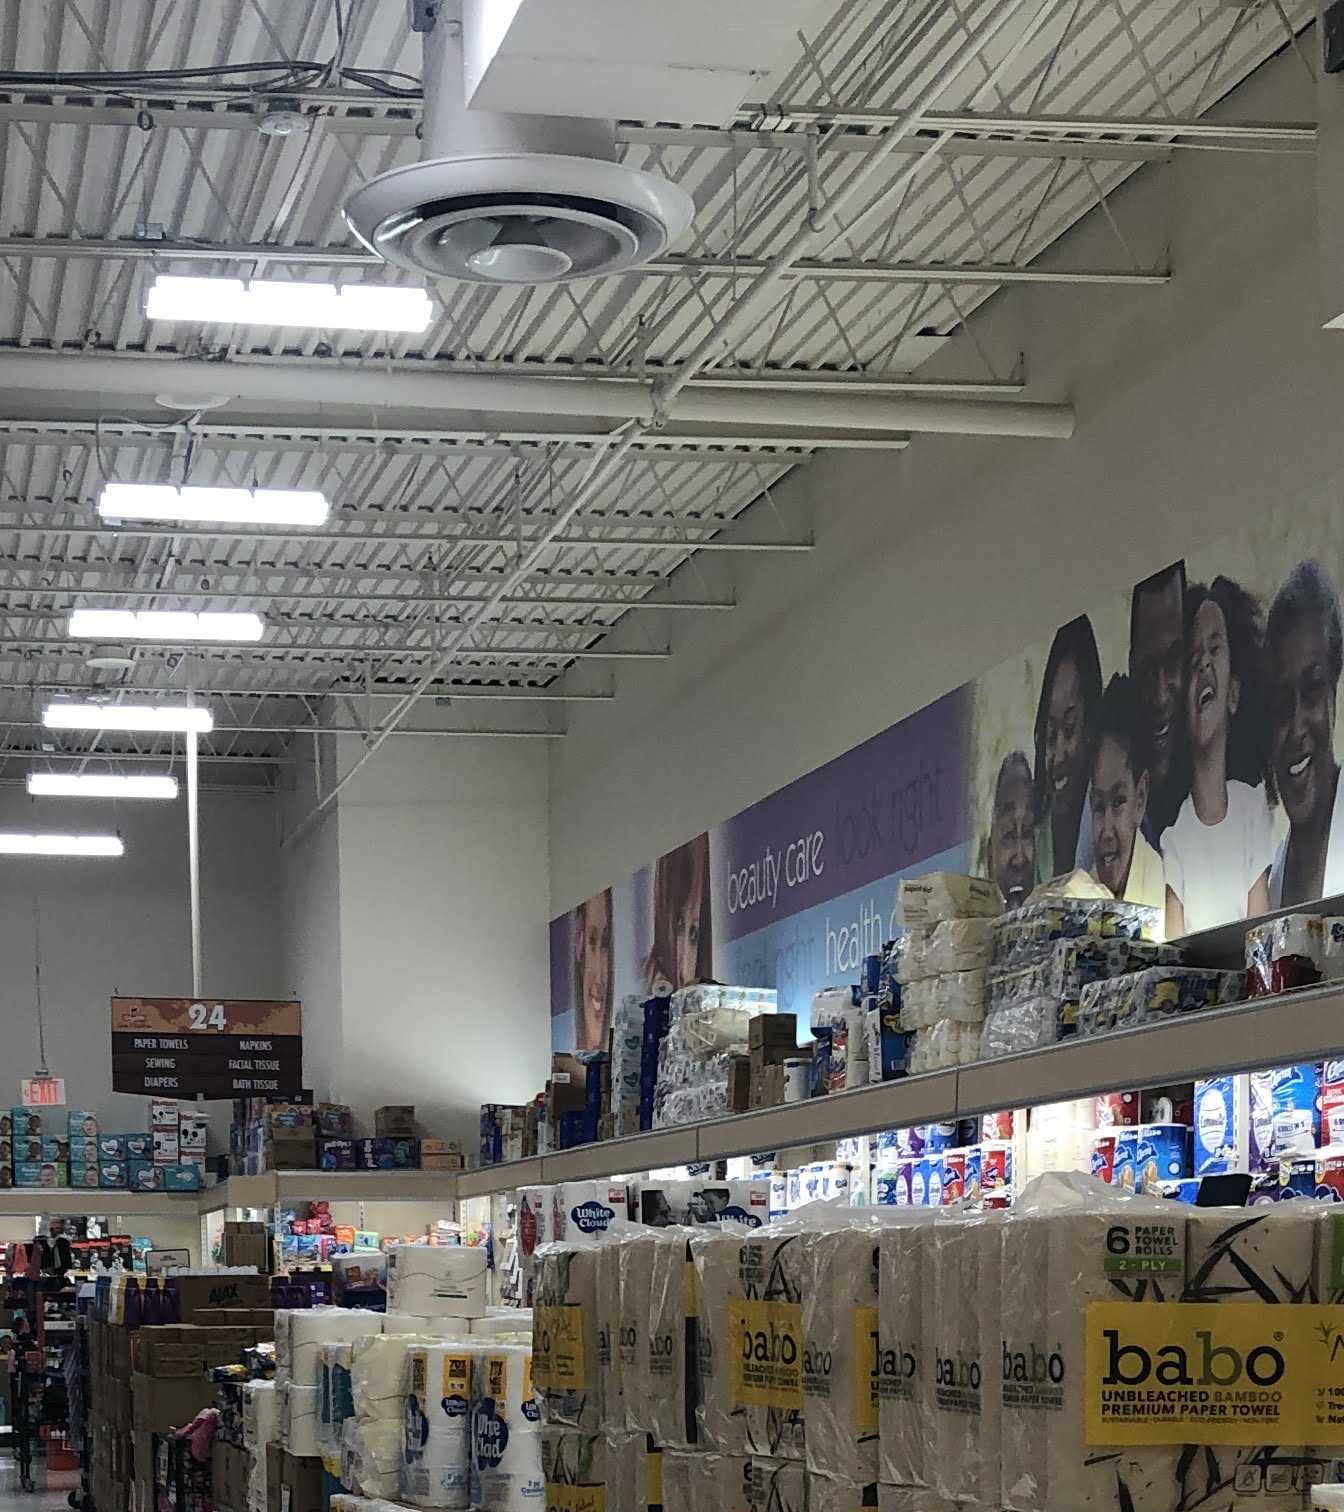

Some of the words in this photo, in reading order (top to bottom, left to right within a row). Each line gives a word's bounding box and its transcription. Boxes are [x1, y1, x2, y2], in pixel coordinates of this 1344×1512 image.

[727, 849, 783, 914] beauty
[786, 829, 824, 887] care
[826, 899, 883, 977] health
[188, 1003, 227, 1031] 24
[134, 1038, 157, 1049] PAPER
[159, 1039, 189, 1050] TOWELS
[239, 1040, 273, 1051] NAPKINS
[145, 1057, 176, 1069] SEWING
[229, 1059, 253, 1070] FACIAL
[255, 1059, 281, 1071] TISSUE
[144, 1076, 179, 1088] DIAPERS
[232, 1078, 252, 1090] BATH
[253, 1079, 279, 1091] TISSUE
[576, 1206, 610, 1219] White
[578, 1216, 610, 1229] Cloud
[1134, 1226, 1175, 1236] PAPER
[1106, 1226, 1130, 1255] 6
[1134, 1236, 1179, 1246] TOWEL
[1134, 1246, 1174, 1256] ROLLS
[1101, 1329, 1285, 1387] babo
[1101, 1390, 1209, 1403] UNBLEACHED
[1213, 1390, 1283, 1403] BAMBOO
[1101, 1404, 1175, 1417] PREMIUM
[1180, 1404, 1228, 1416] PAPER
[1231, 1403, 1281, 1417] TOWEL
